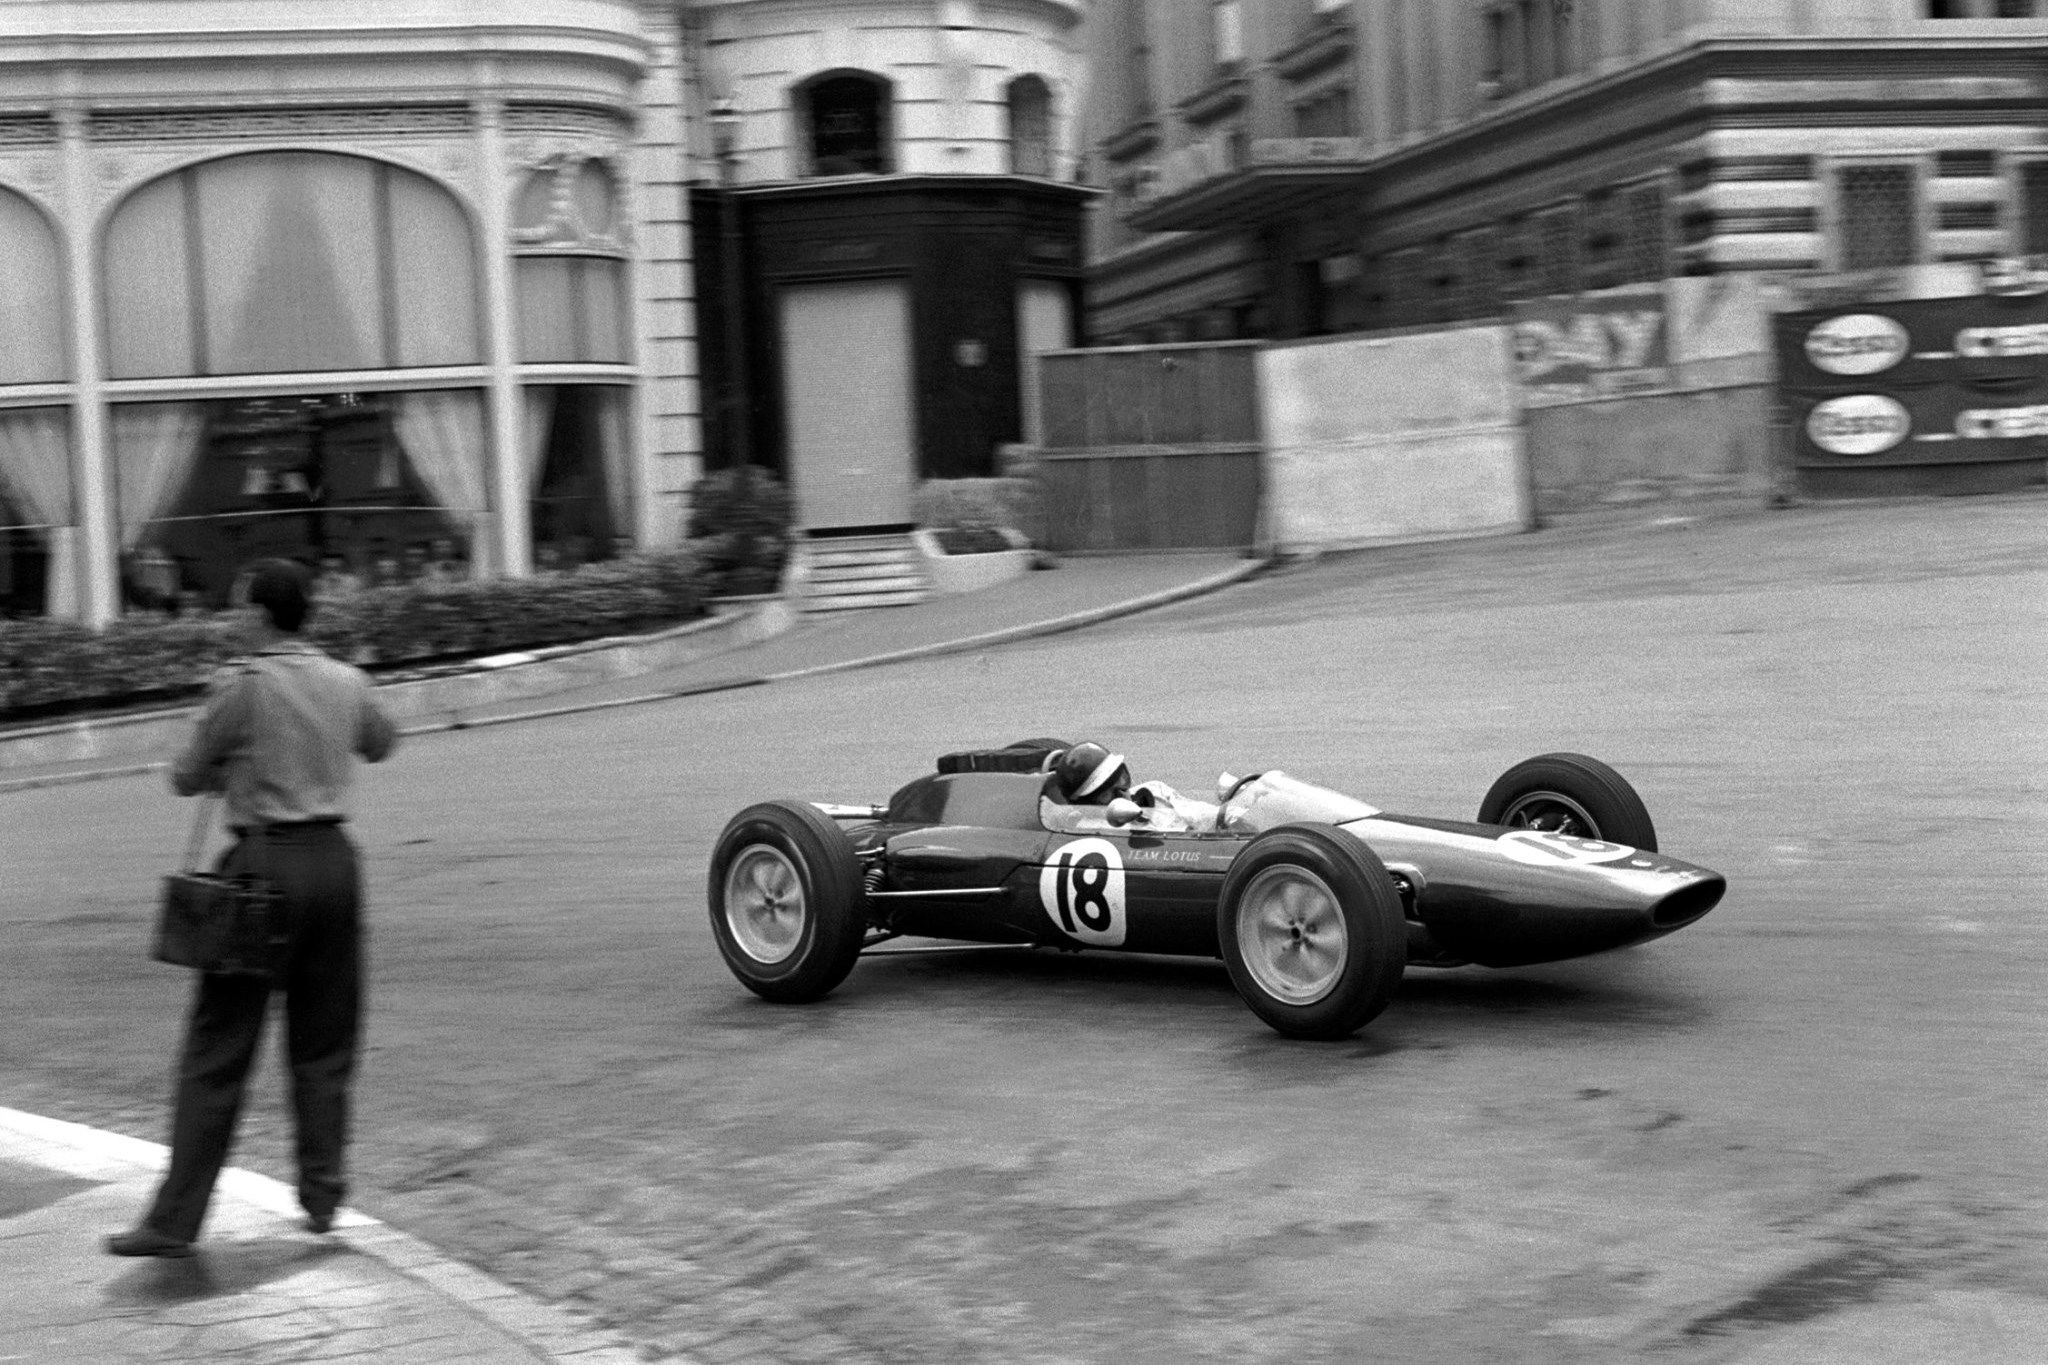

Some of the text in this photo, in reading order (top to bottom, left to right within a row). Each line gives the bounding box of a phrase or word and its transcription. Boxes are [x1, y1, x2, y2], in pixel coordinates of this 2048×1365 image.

[1127, 849, 1202, 862] TEAM LOTUS
[1511, 832, 1621, 861] 18
[1056, 851, 1111, 933] 18
